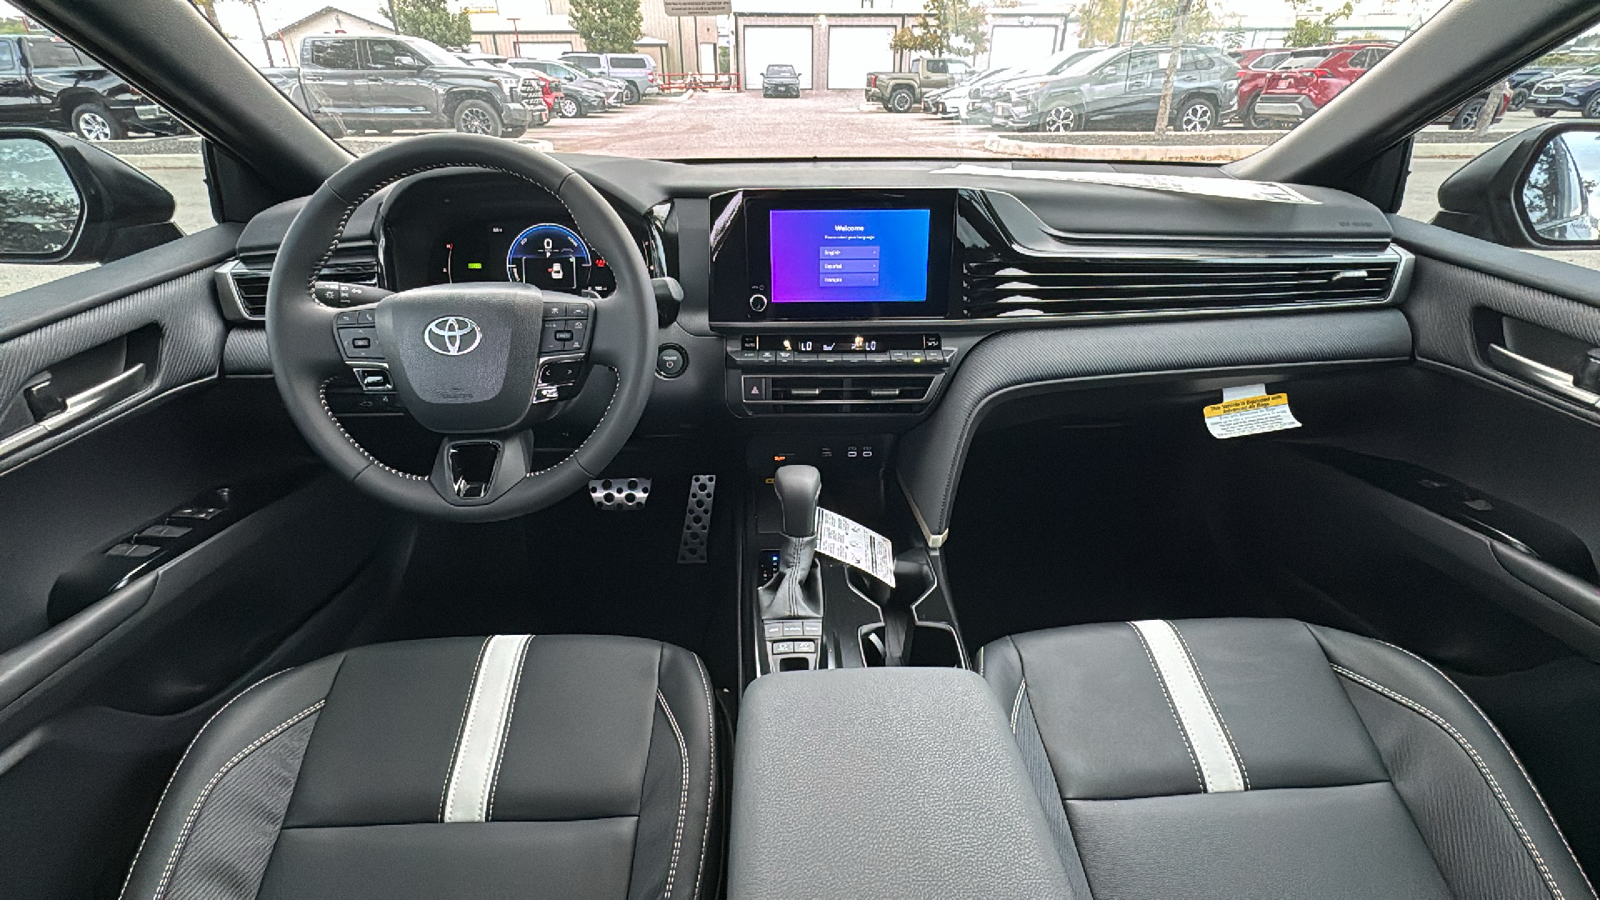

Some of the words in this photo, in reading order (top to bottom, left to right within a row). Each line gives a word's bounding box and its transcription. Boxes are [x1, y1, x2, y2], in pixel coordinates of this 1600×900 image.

[544, 238, 552, 249] 0
[802, 342, 812, 350] LO
[866, 341, 876, 350] LO
